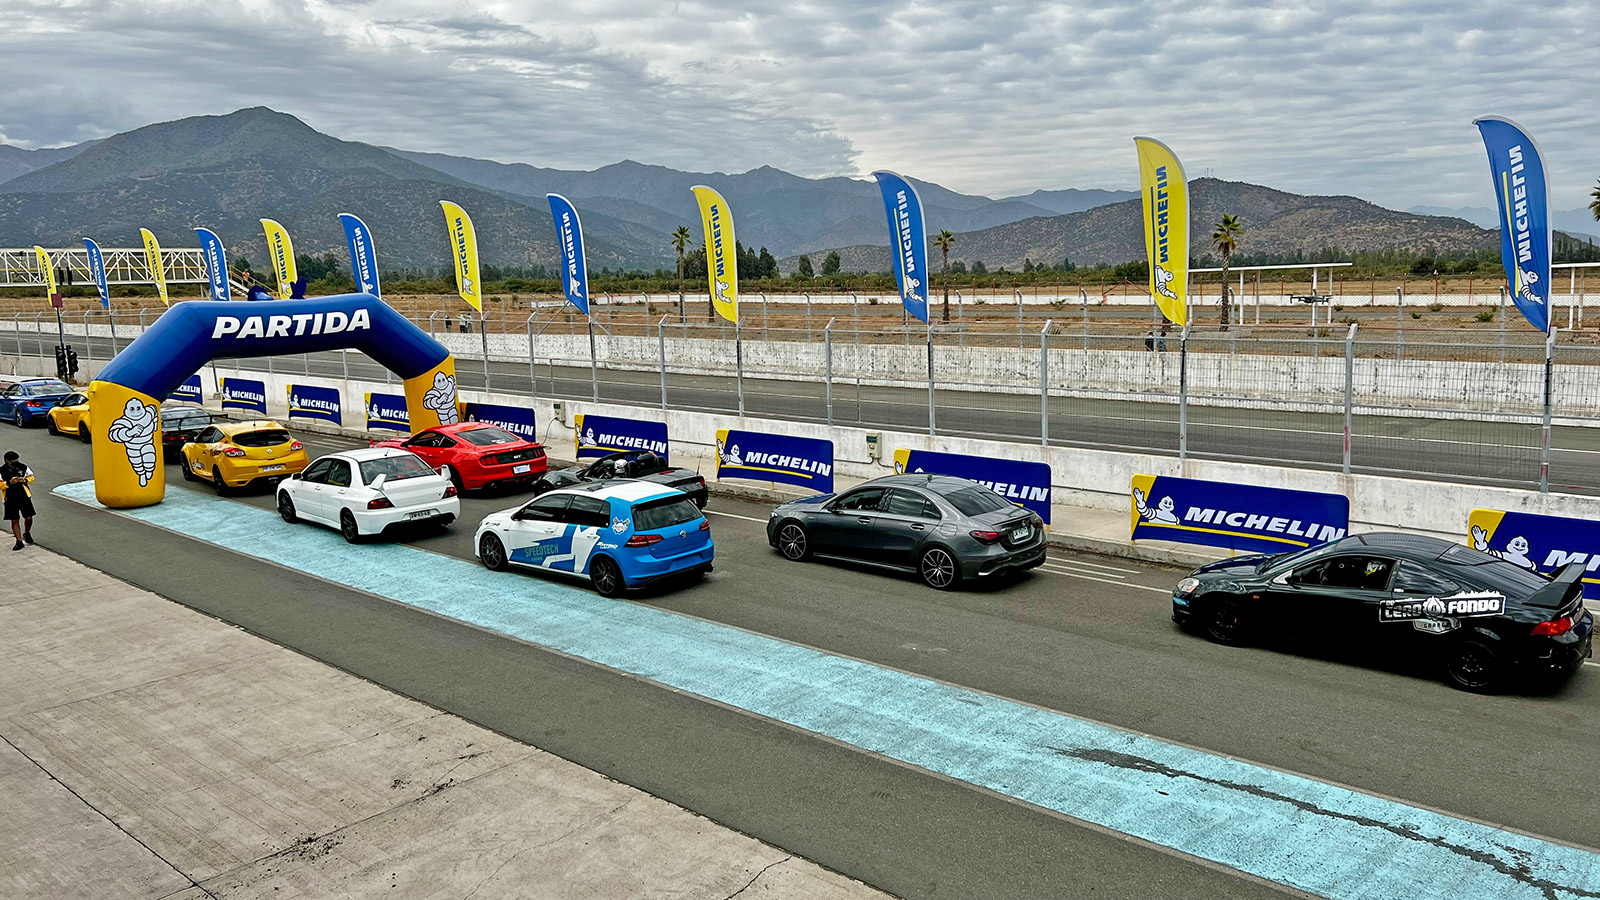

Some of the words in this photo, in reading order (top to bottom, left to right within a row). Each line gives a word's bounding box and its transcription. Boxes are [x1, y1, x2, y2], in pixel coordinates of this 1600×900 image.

[211, 308, 371, 339] PARTIDA
[177, 384, 200, 394] CHELIN
[231, 390, 264, 403] MICHELIN
[300, 398, 339, 413] MICHELIN
[380, 408, 410, 420] MICHE
[598, 433, 667, 454] MICHELIN
[744, 451, 832, 477] MICHELIN
[1184, 506, 1346, 542] MICHELIN
[1447, 599, 1500, 615] FONDO
